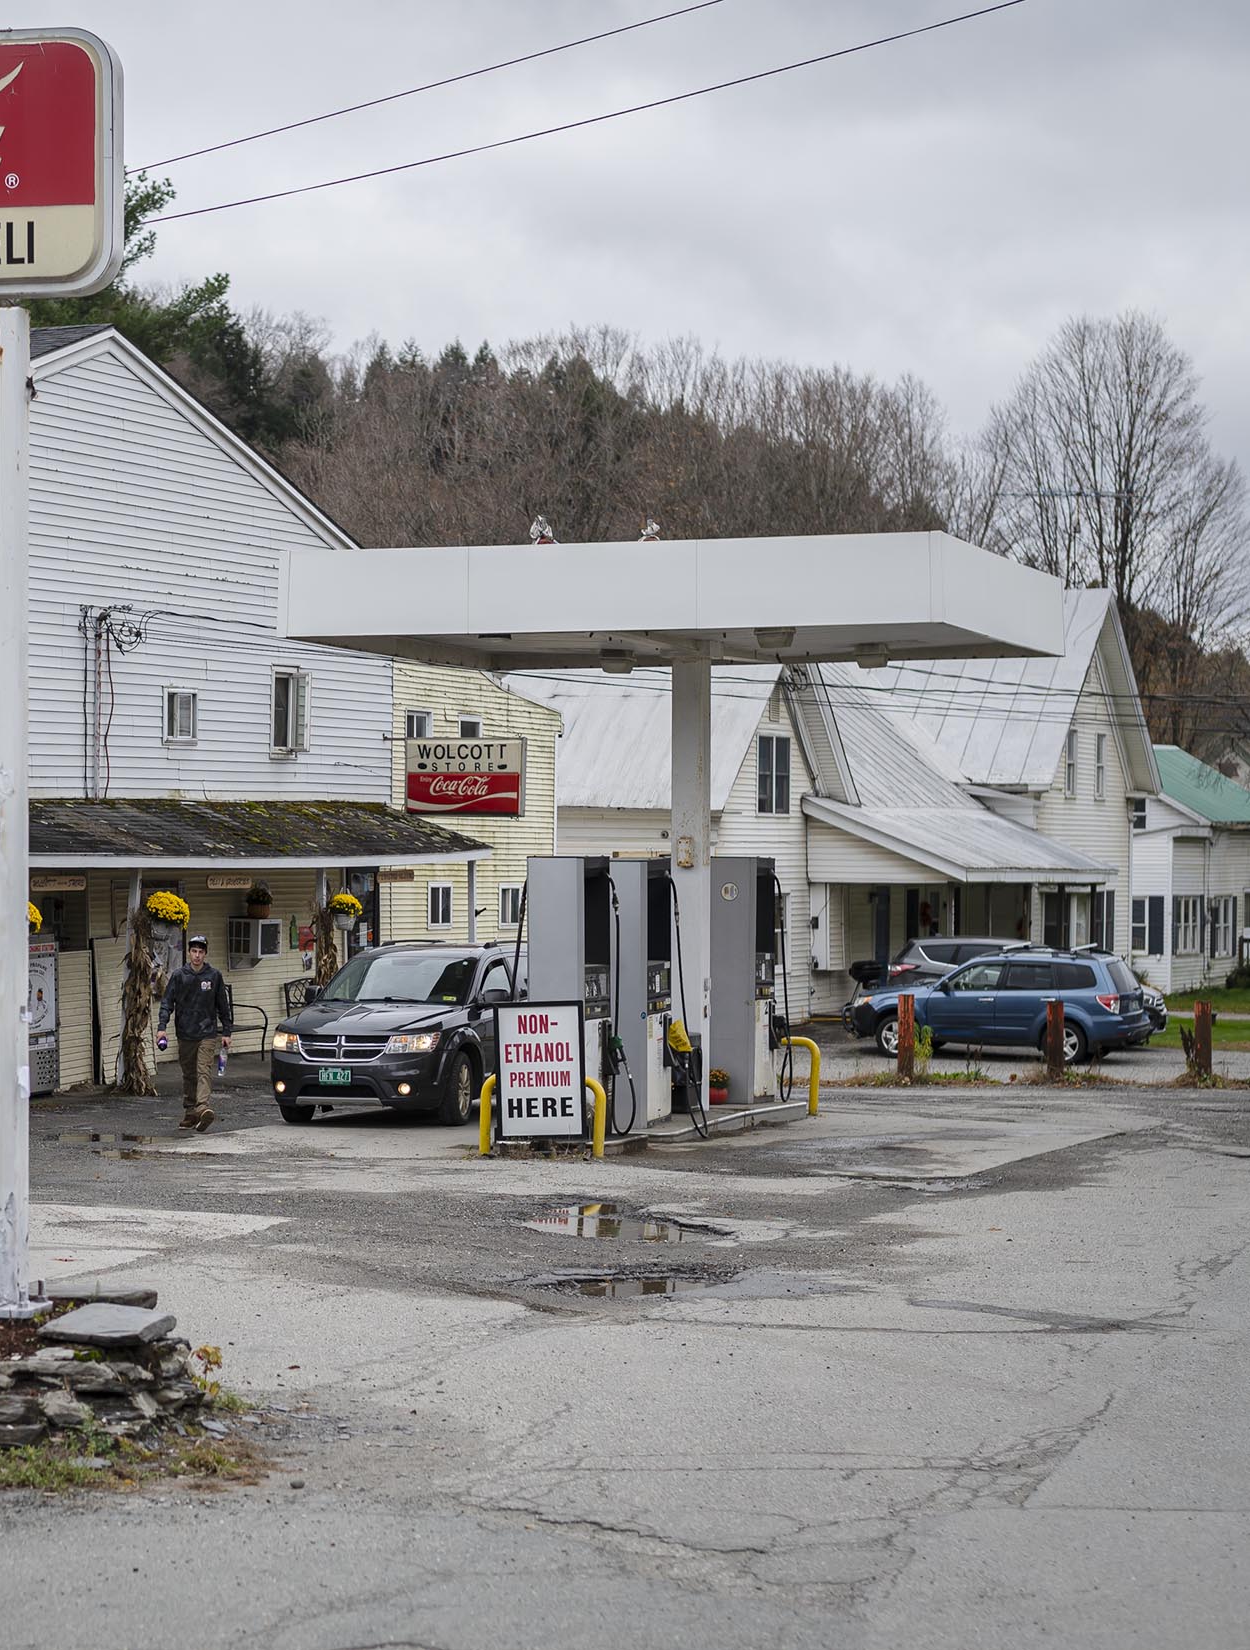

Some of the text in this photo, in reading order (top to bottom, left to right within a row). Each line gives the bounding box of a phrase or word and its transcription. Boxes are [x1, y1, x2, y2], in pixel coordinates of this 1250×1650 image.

[417, 744, 507, 760] WOLCOTT
[431, 762, 494, 772] STORE
[430, 775, 491, 796] Coca-Cola
[517, 1014, 558, 1034] NON-
[504, 1042, 574, 1063] ETHANOL
[510, 1071, 571, 1088] PREMIUM
[507, 1097, 574, 1118] HERE
